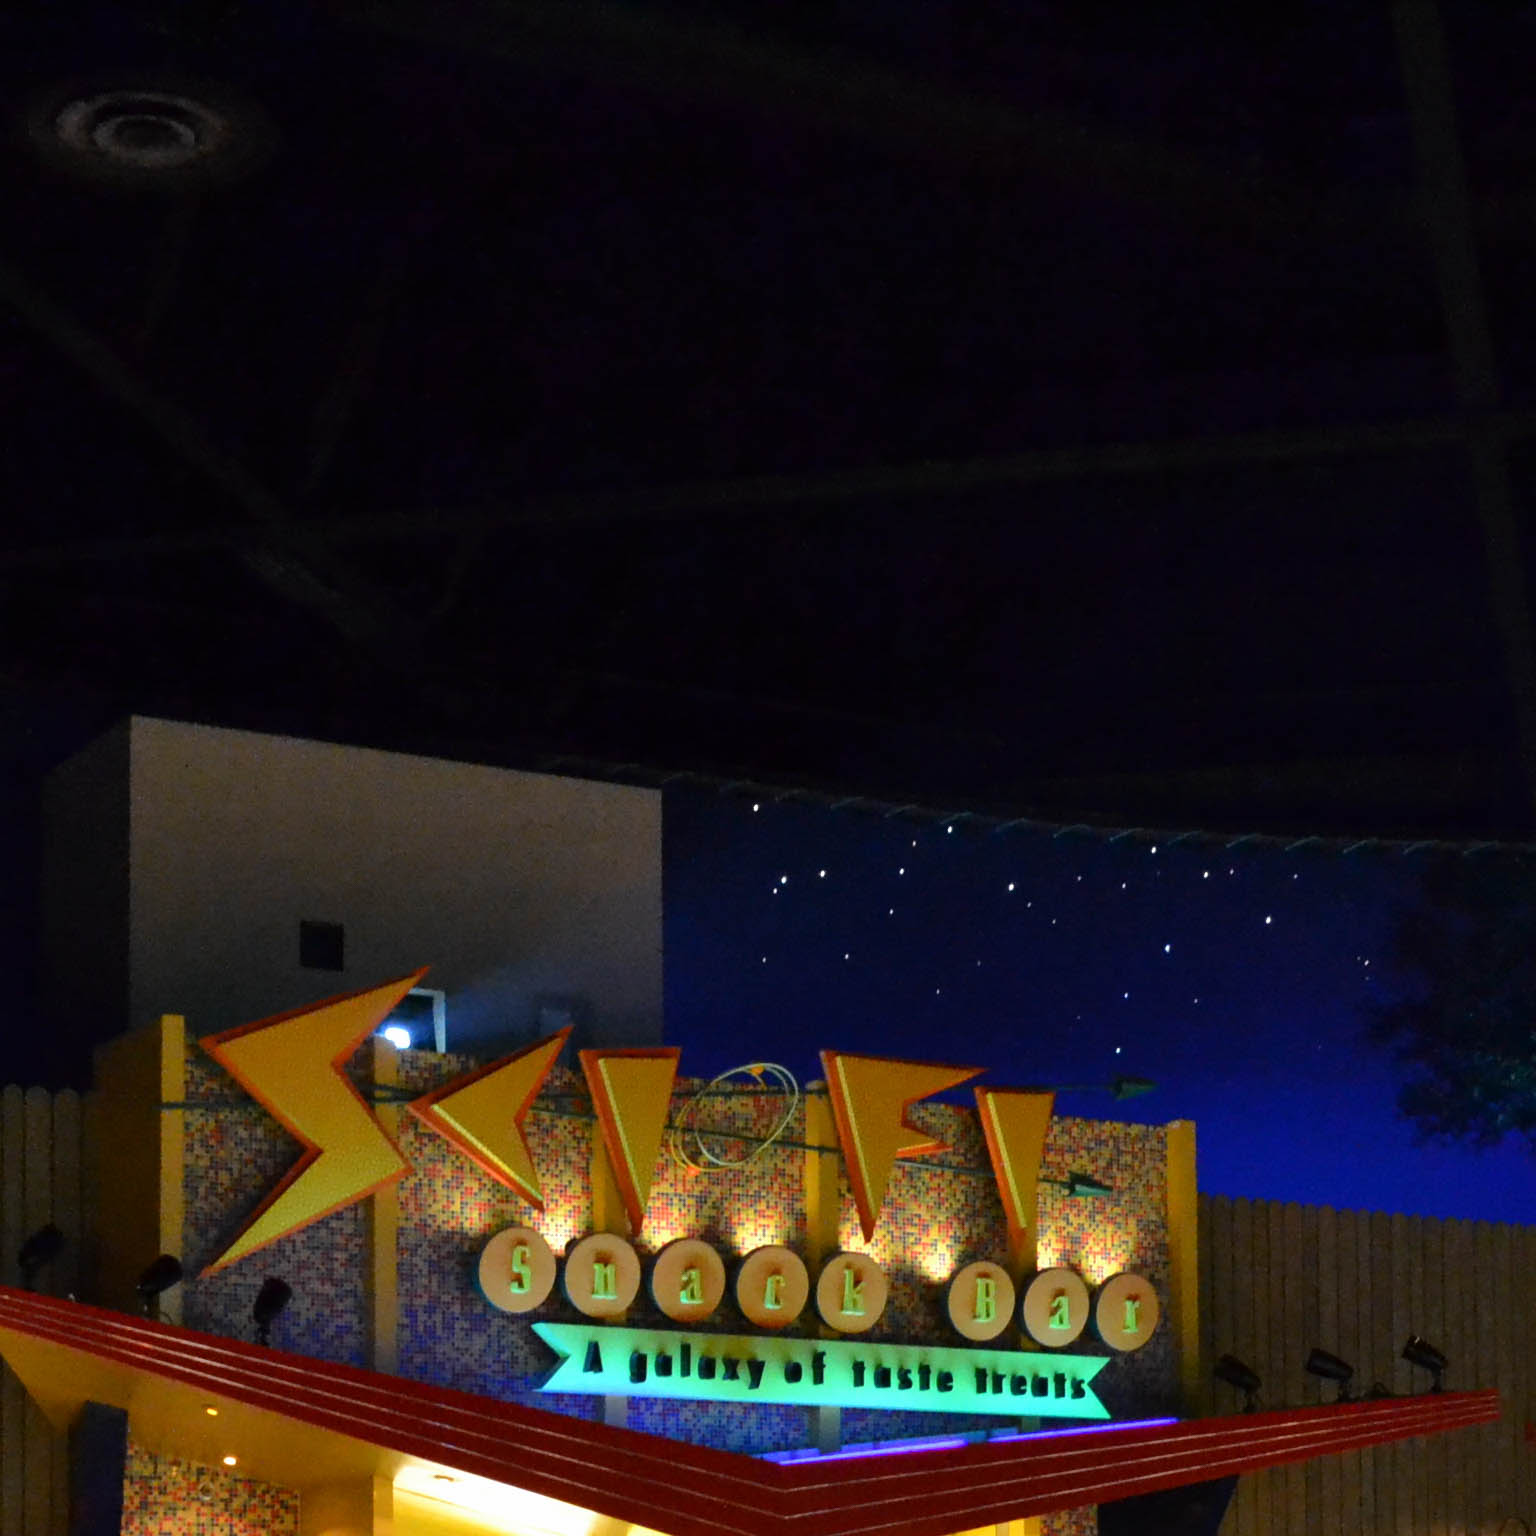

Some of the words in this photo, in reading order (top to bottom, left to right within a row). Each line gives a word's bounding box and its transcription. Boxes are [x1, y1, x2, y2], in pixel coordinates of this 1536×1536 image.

[510, 1245, 867, 1317] Snack
[972, 1277, 1140, 1334] Bar
[583, 1341, 603, 1374] A
[628, 1342, 766, 1390] galaxy
[783, 1350, 826, 1385] of
[851, 1356, 955, 1394] taste
[974, 1366, 1087, 1400] treats
